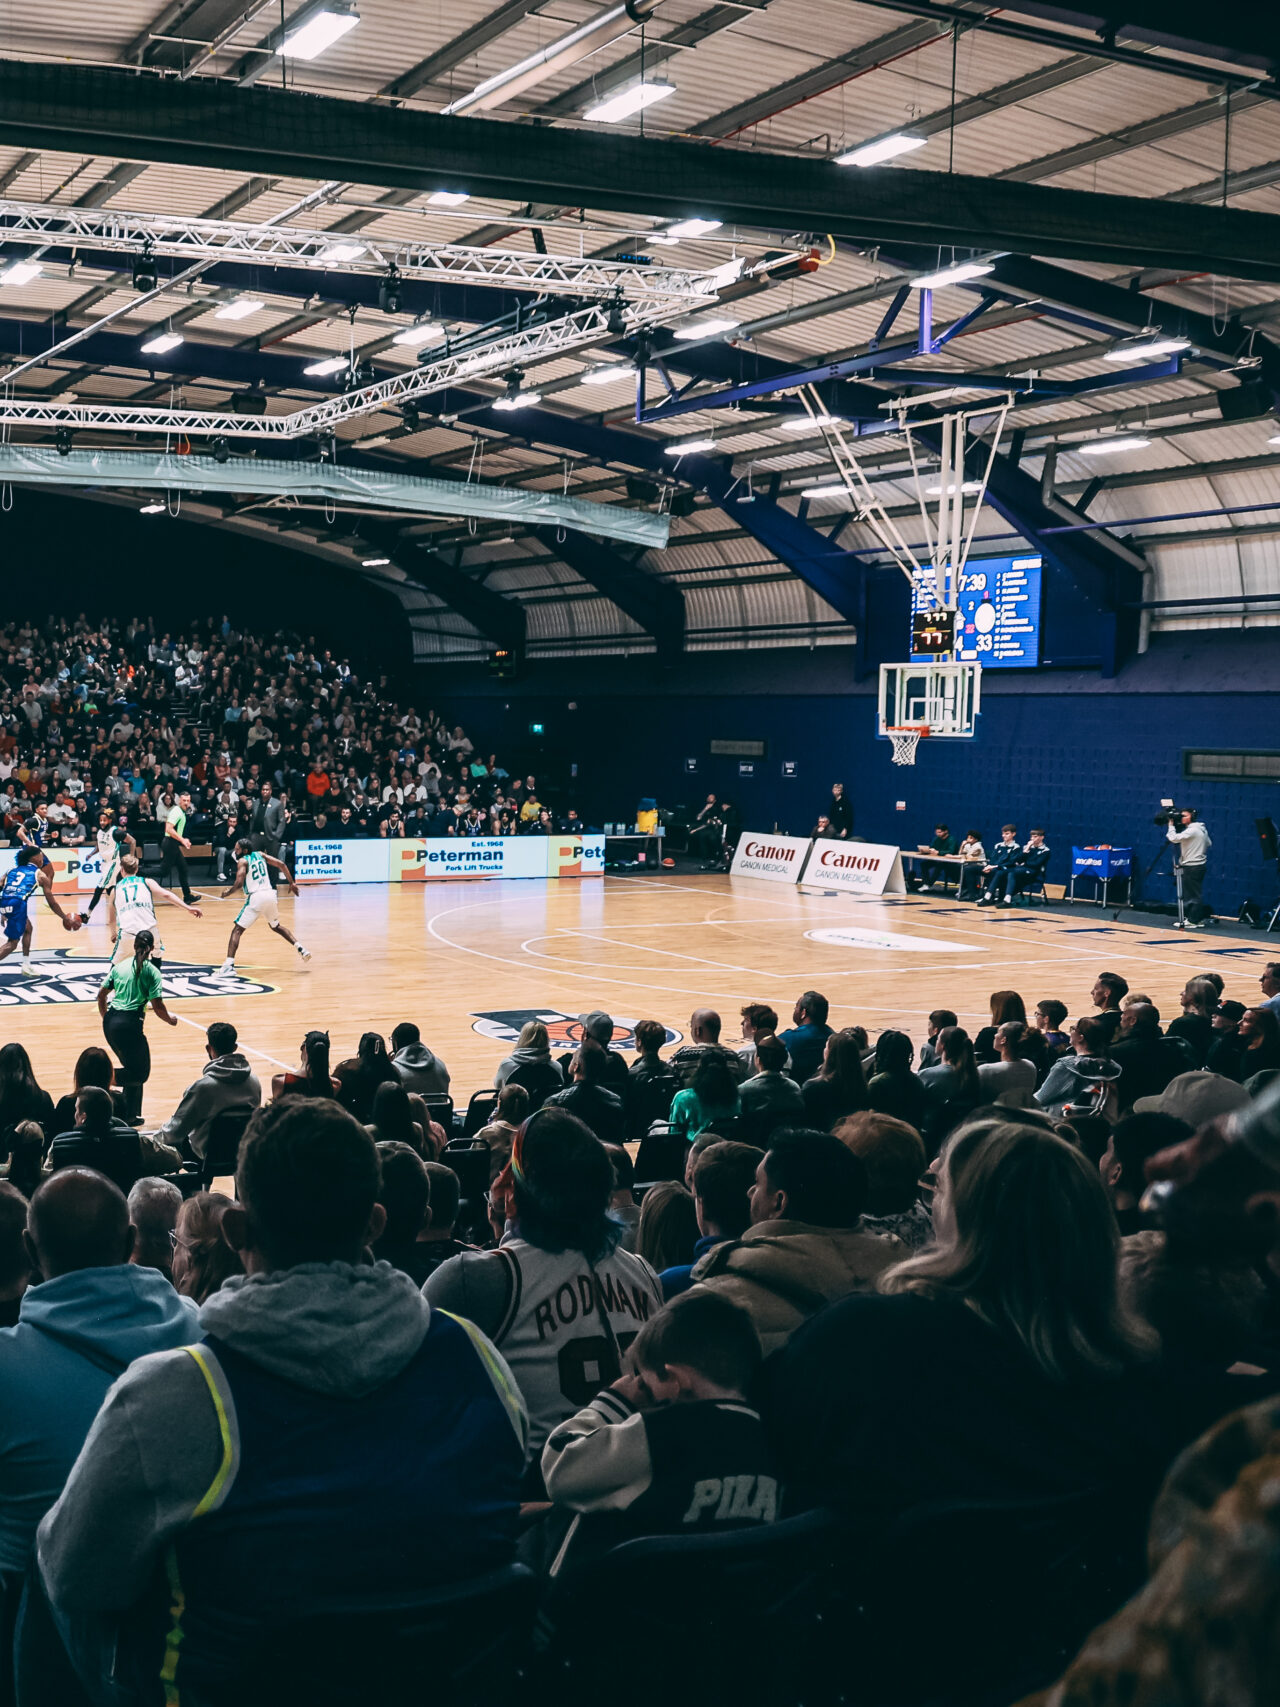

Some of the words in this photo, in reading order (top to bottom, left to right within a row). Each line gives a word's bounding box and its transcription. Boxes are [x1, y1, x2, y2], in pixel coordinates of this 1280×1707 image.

[976, 634, 993, 652] 33
[416, 849, 504, 862] Peterman
[745, 841, 796, 862] Canon
[740, 860, 761, 870] CANON
[762, 862, 789, 874] MEDICAL
[820, 850, 881, 872] Canon
[11, 871, 26, 886] 3
[252, 862, 266, 881] 20
[815, 869, 840, 880] CANON
[841, 872, 872, 885] MEDICAL
[122, 884, 139, 903] 17
[535, 1272, 649, 1340] RODMAN
